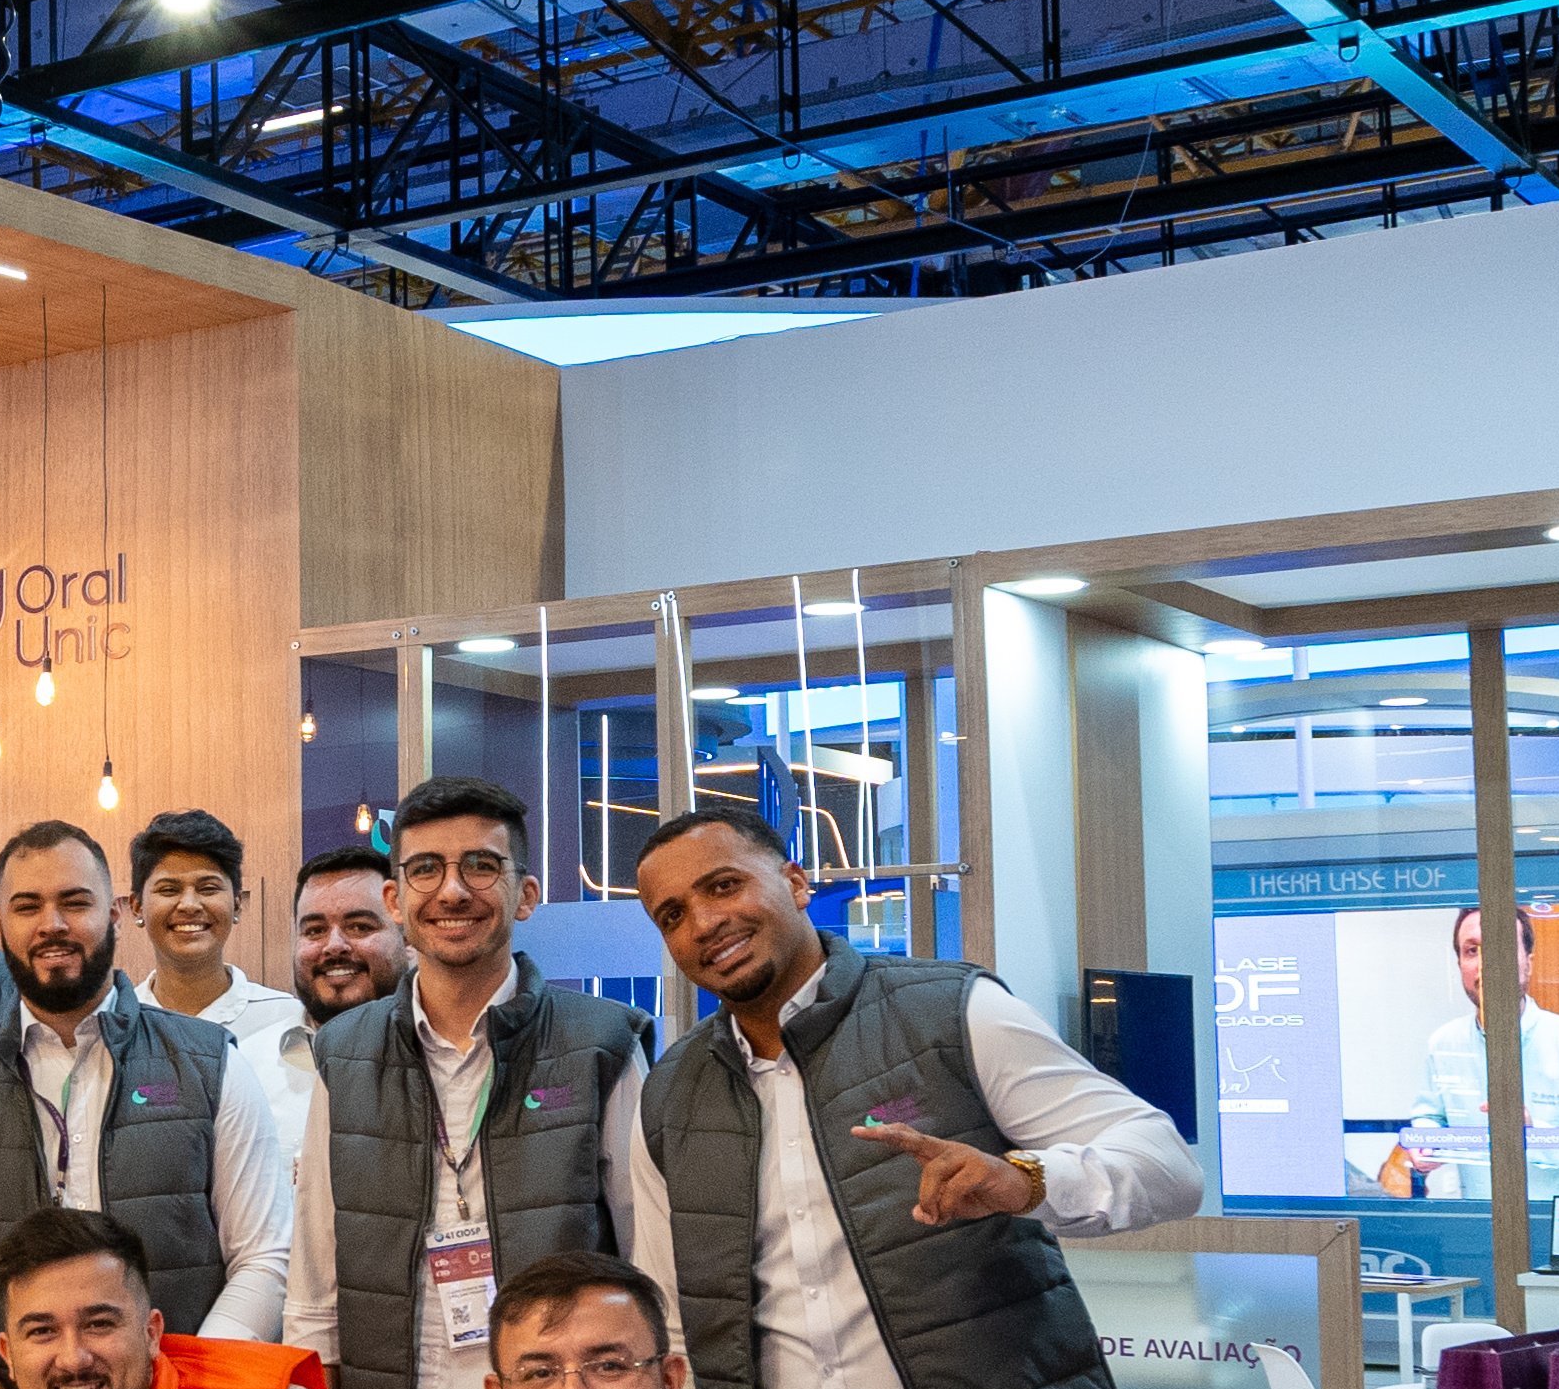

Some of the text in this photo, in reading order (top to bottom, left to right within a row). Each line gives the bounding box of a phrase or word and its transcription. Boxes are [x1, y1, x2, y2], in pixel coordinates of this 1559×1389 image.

[16, 553, 127, 613] Oral
[16, 615, 131, 668] Unic
[1250, 866, 1447, 897] THERA LASE HOF
[1219, 956, 1298, 972] LASE
[1214, 973, 1300, 1013] OF
[1215, 1014, 1304, 1027] CIADOS
[1404, 1132, 1424, 1144] Nós
[1426, 1133, 1483, 1144] escolhemos
[1098, 1336, 1302, 1369] DE AVALIAÇO
